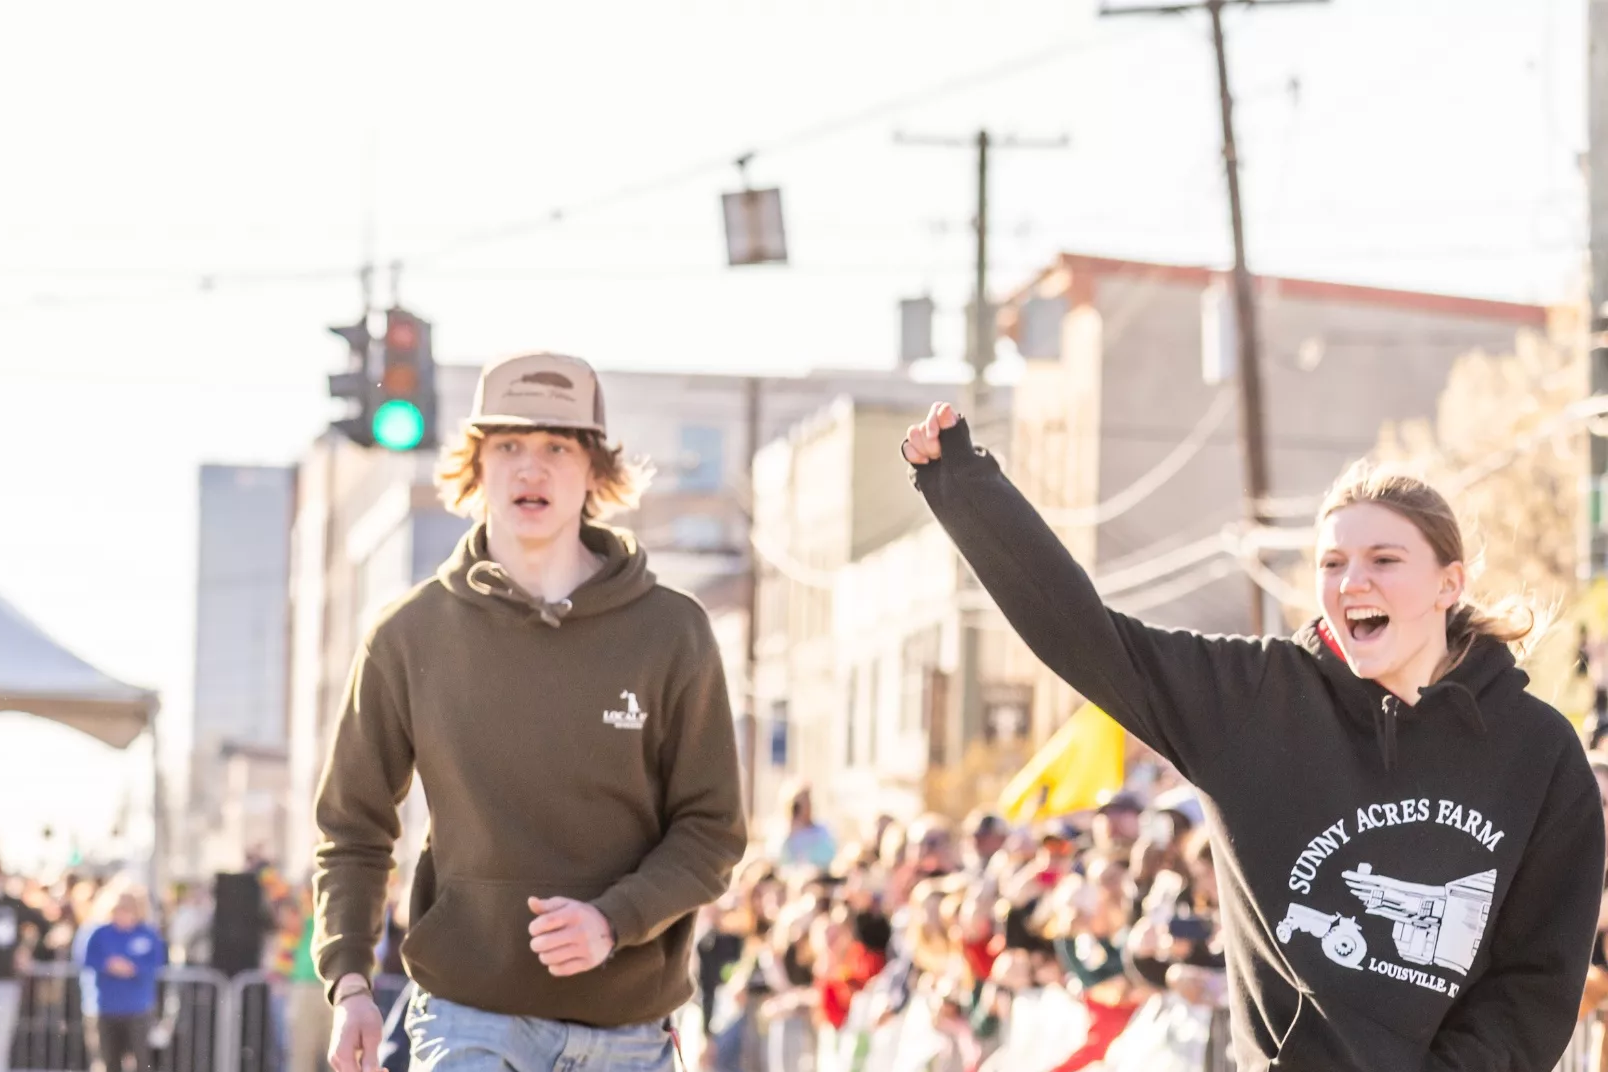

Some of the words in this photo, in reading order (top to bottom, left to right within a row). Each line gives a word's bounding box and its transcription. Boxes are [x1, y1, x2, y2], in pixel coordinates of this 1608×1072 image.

[1288, 818, 1351, 895] SUNNY
[1356, 798, 1430, 833] ACRES
[1435, 799, 1505, 852] FARM
[1447, 982, 1460, 998] K
